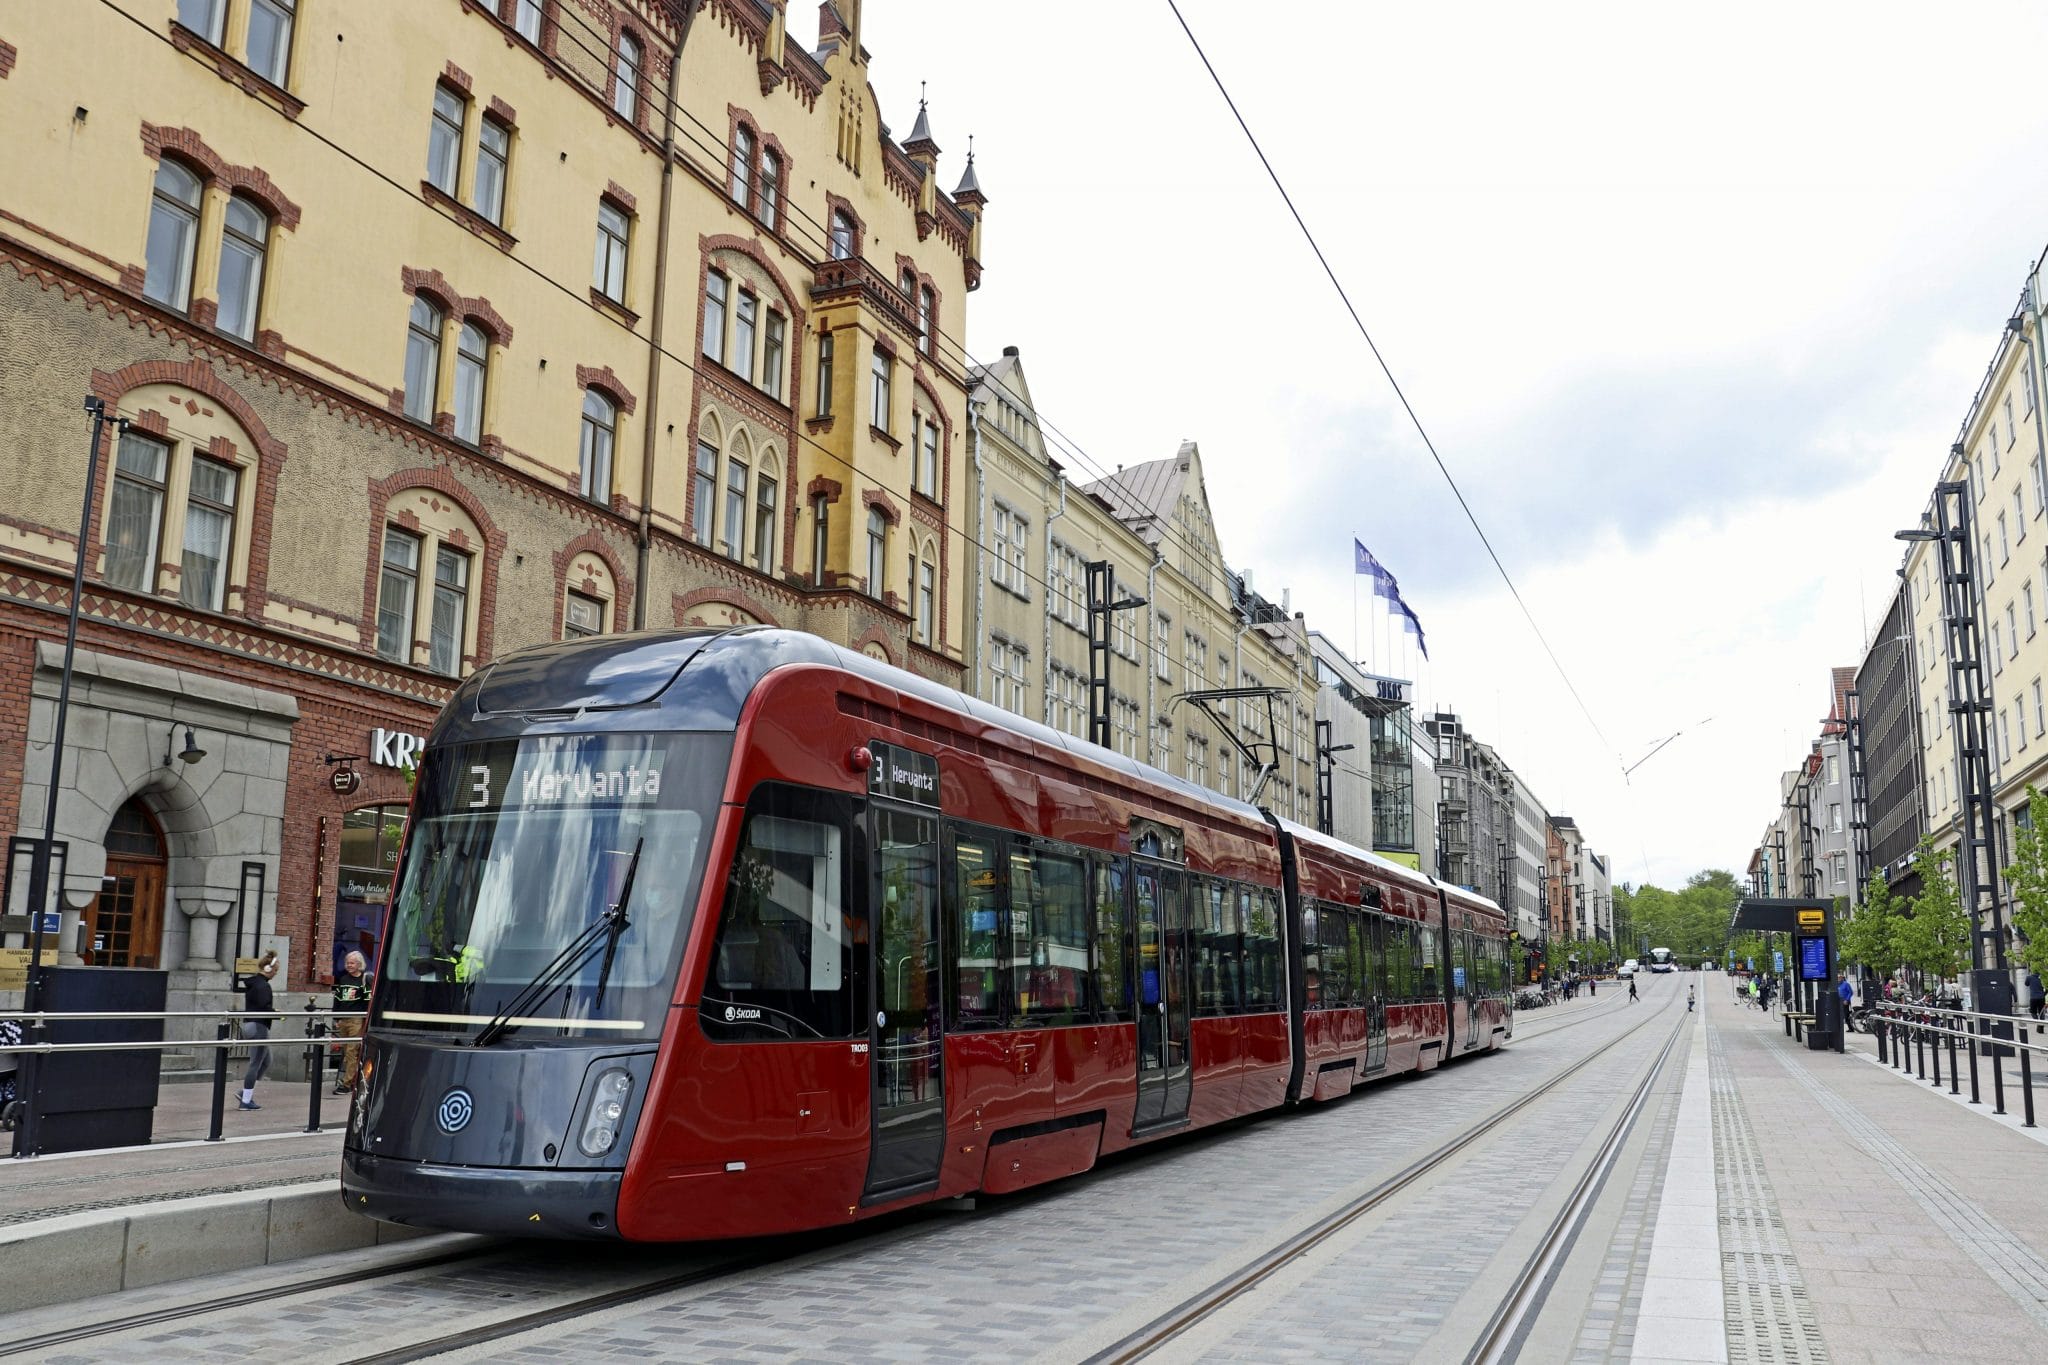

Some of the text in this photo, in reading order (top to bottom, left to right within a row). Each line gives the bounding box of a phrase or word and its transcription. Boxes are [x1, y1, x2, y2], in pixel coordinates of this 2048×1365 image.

[1376, 680, 1402, 700] SOKOS
[469, 765, 660, 807] 3 Hervanta
[876, 756, 933, 791] 3 Hervanta
[735, 1008, 761, 1019] ŠKODA
